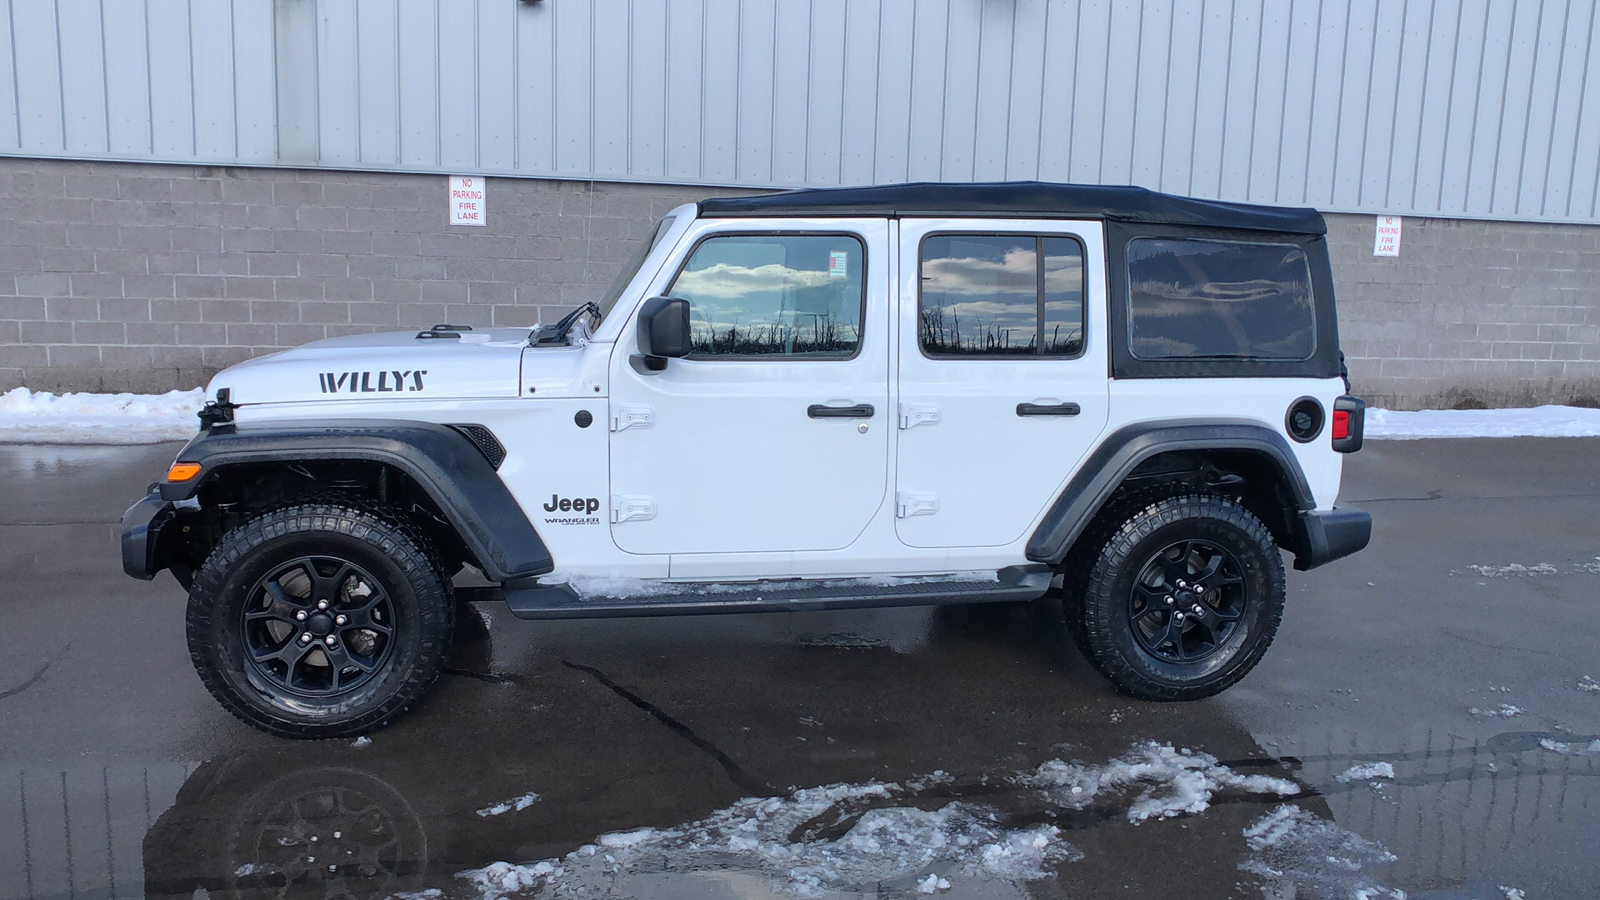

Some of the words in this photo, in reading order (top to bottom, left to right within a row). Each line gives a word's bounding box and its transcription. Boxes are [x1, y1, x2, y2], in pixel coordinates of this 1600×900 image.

[462, 178, 473, 188] NO
[452, 190, 482, 200] PARKING
[458, 202, 477, 211] FIRE
[457, 212, 479, 221] LANE
[319, 370, 428, 394] WILLYS
[543, 494, 600, 515] Jeep
